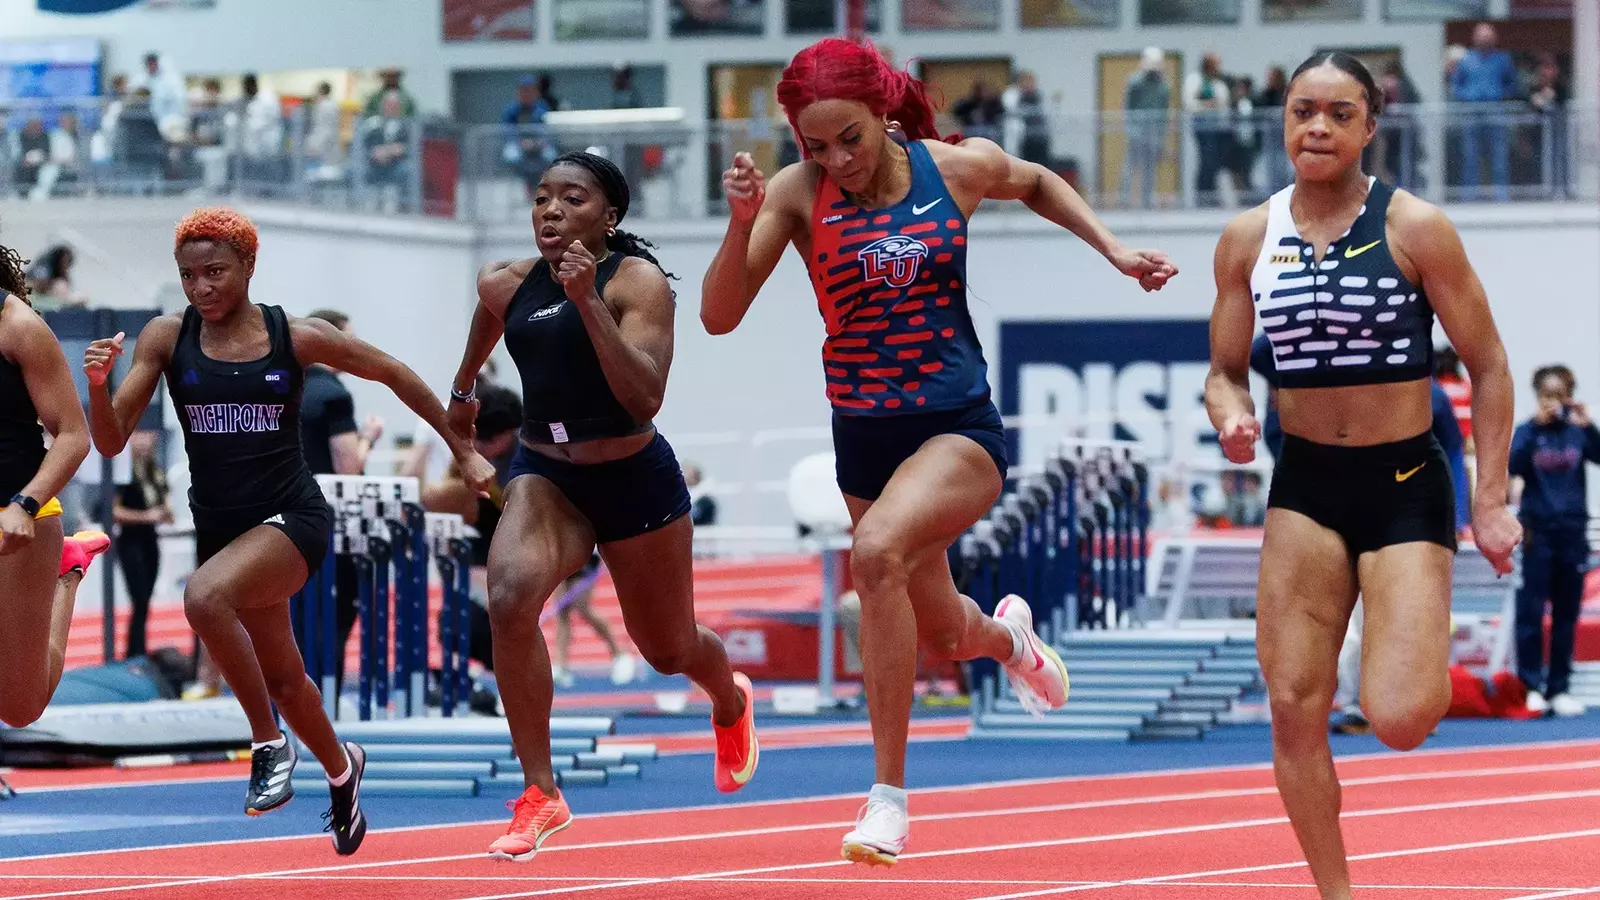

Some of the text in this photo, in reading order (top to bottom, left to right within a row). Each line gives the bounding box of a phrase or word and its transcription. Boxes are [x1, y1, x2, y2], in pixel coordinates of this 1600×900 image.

[858, 247, 920, 288] LU
[533, 306, 560, 318] NIKE
[185, 403, 284, 433] HIGH POINT
